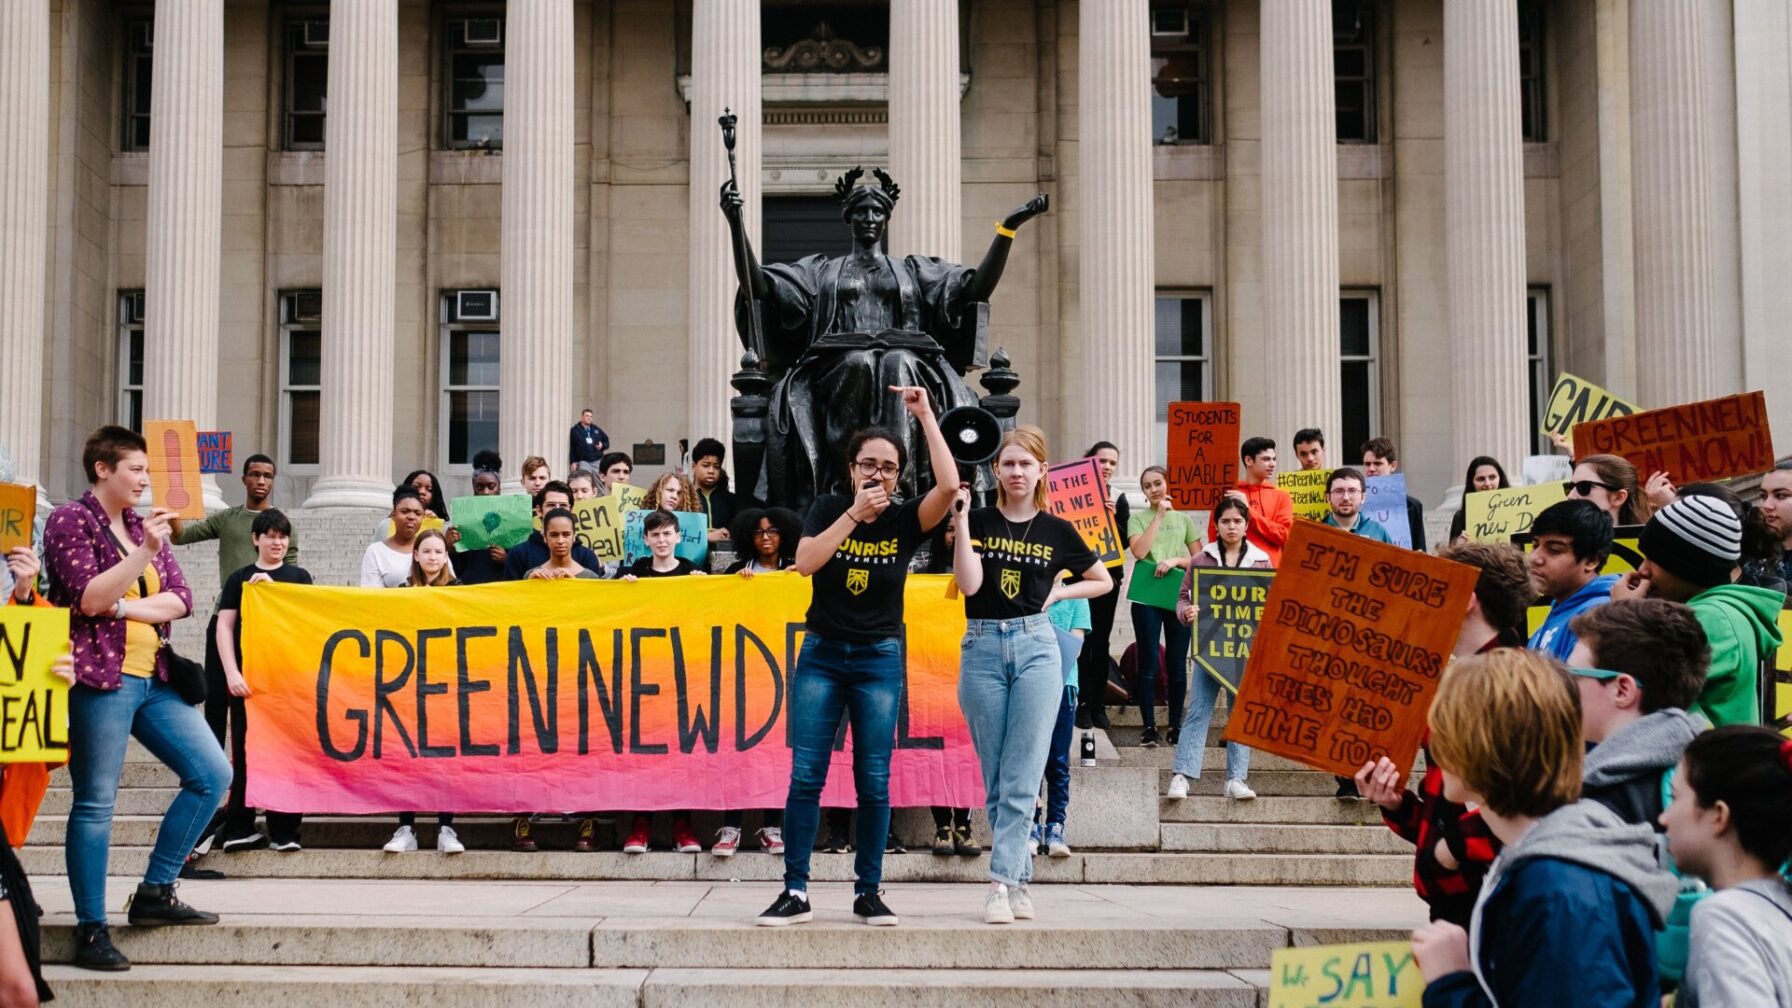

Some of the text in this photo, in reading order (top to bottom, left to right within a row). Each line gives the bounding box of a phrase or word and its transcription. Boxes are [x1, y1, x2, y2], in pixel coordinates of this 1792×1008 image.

[1173, 409, 1237, 426] STUDENTS
[1592, 394, 1761, 452] GREEN NEW
[1188, 430, 1214, 446] FOR
[1194, 447, 1205, 462] A
[1062, 474, 1089, 489] THE
[1168, 464, 1235, 485] LIVABLE
[1069, 493, 1095, 510] WE
[1487, 494, 1533, 521] Green
[1074, 516, 1100, 530] THE
[1474, 521, 1509, 538] new
[1301, 542, 1448, 608] I'M SURE
[1210, 585, 1267, 602] OUR
[1210, 604, 1265, 620] TIME
[1330, 587, 1385, 622] THE
[1223, 623, 1253, 638] TO
[1287, 643, 1424, 706] THOUGHT
[316, 626, 558, 762] GREEN
[576, 624, 724, 756] NEW
[1267, 672, 1333, 713] THEY
[1244, 700, 1322, 750] TIME
[1318, 952, 1413, 1004] SAY
